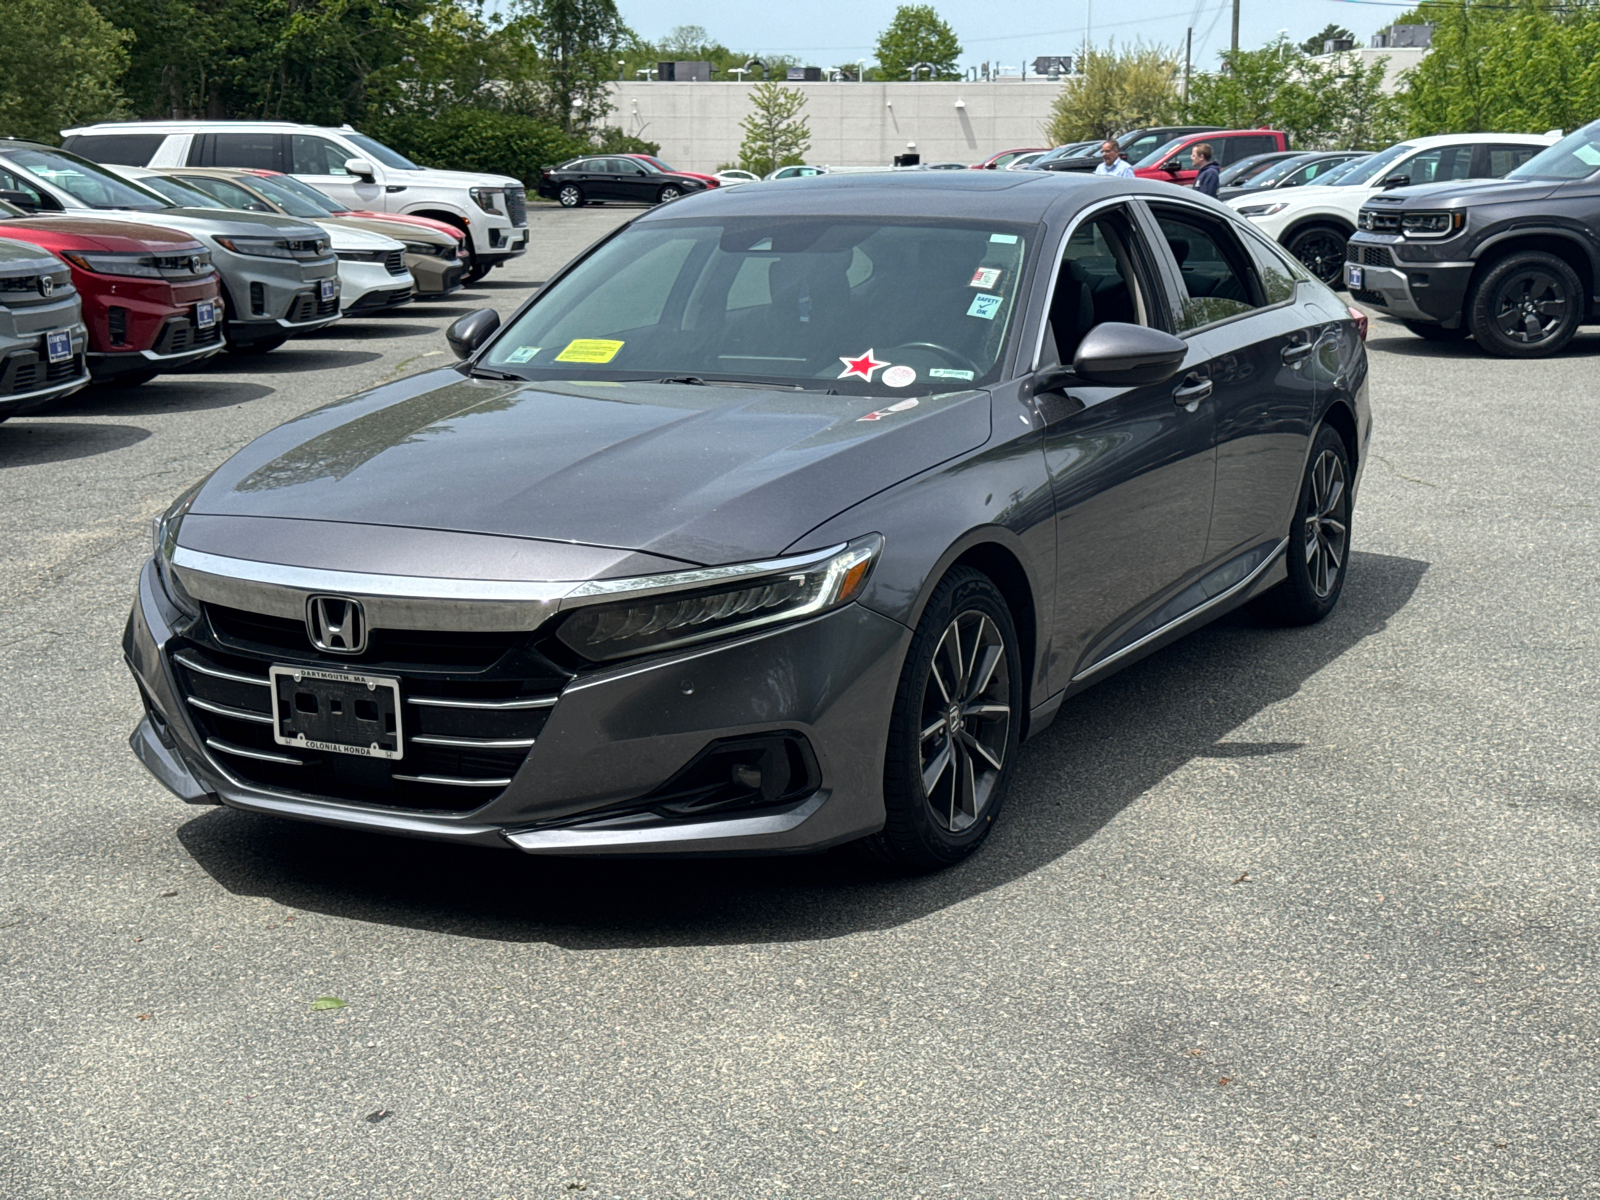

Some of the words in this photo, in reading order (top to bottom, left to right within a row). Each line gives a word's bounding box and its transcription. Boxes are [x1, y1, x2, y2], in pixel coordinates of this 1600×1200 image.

[976, 296, 1000, 305] SAFETY
[301, 669, 352, 682] DARTMOUTH,
[354, 675, 367, 683] MA
[305, 741, 342, 752] COLONIAL
[344, 745, 372, 757] HONDA
